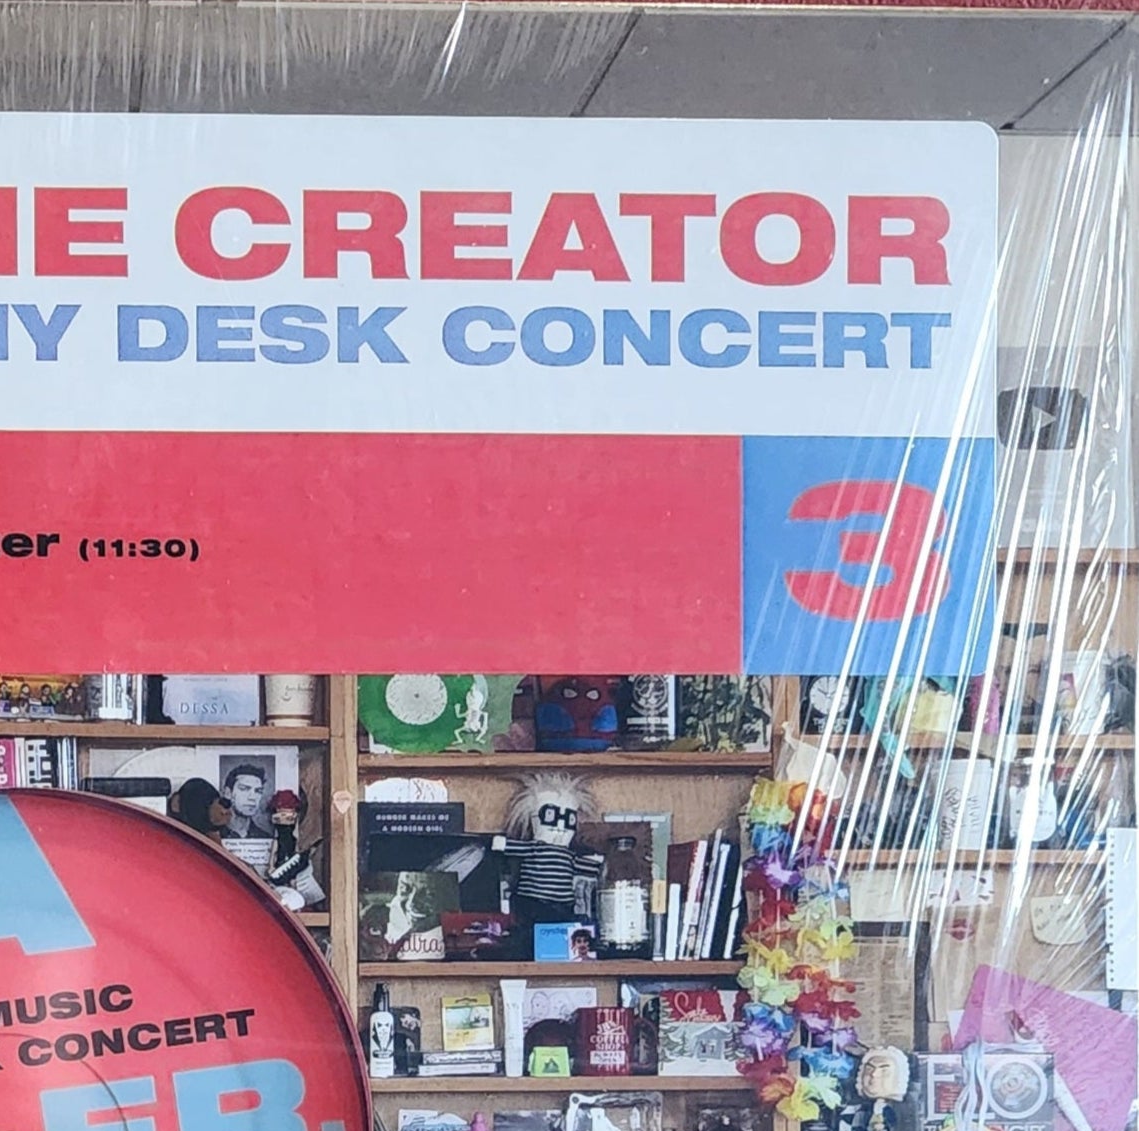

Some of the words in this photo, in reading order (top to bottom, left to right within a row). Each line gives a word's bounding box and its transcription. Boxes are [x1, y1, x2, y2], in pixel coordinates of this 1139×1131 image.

[173, 185, 954, 287] CREATOR
[116, 304, 411, 364] DESK
[441, 304, 953, 370] CONCERT
[78, 538, 201, 561] (11:30)
[783, 479, 952, 622] 3
[179, 701, 229, 715] DESSA
[17, 1008, 257, 1068] CONCERT
